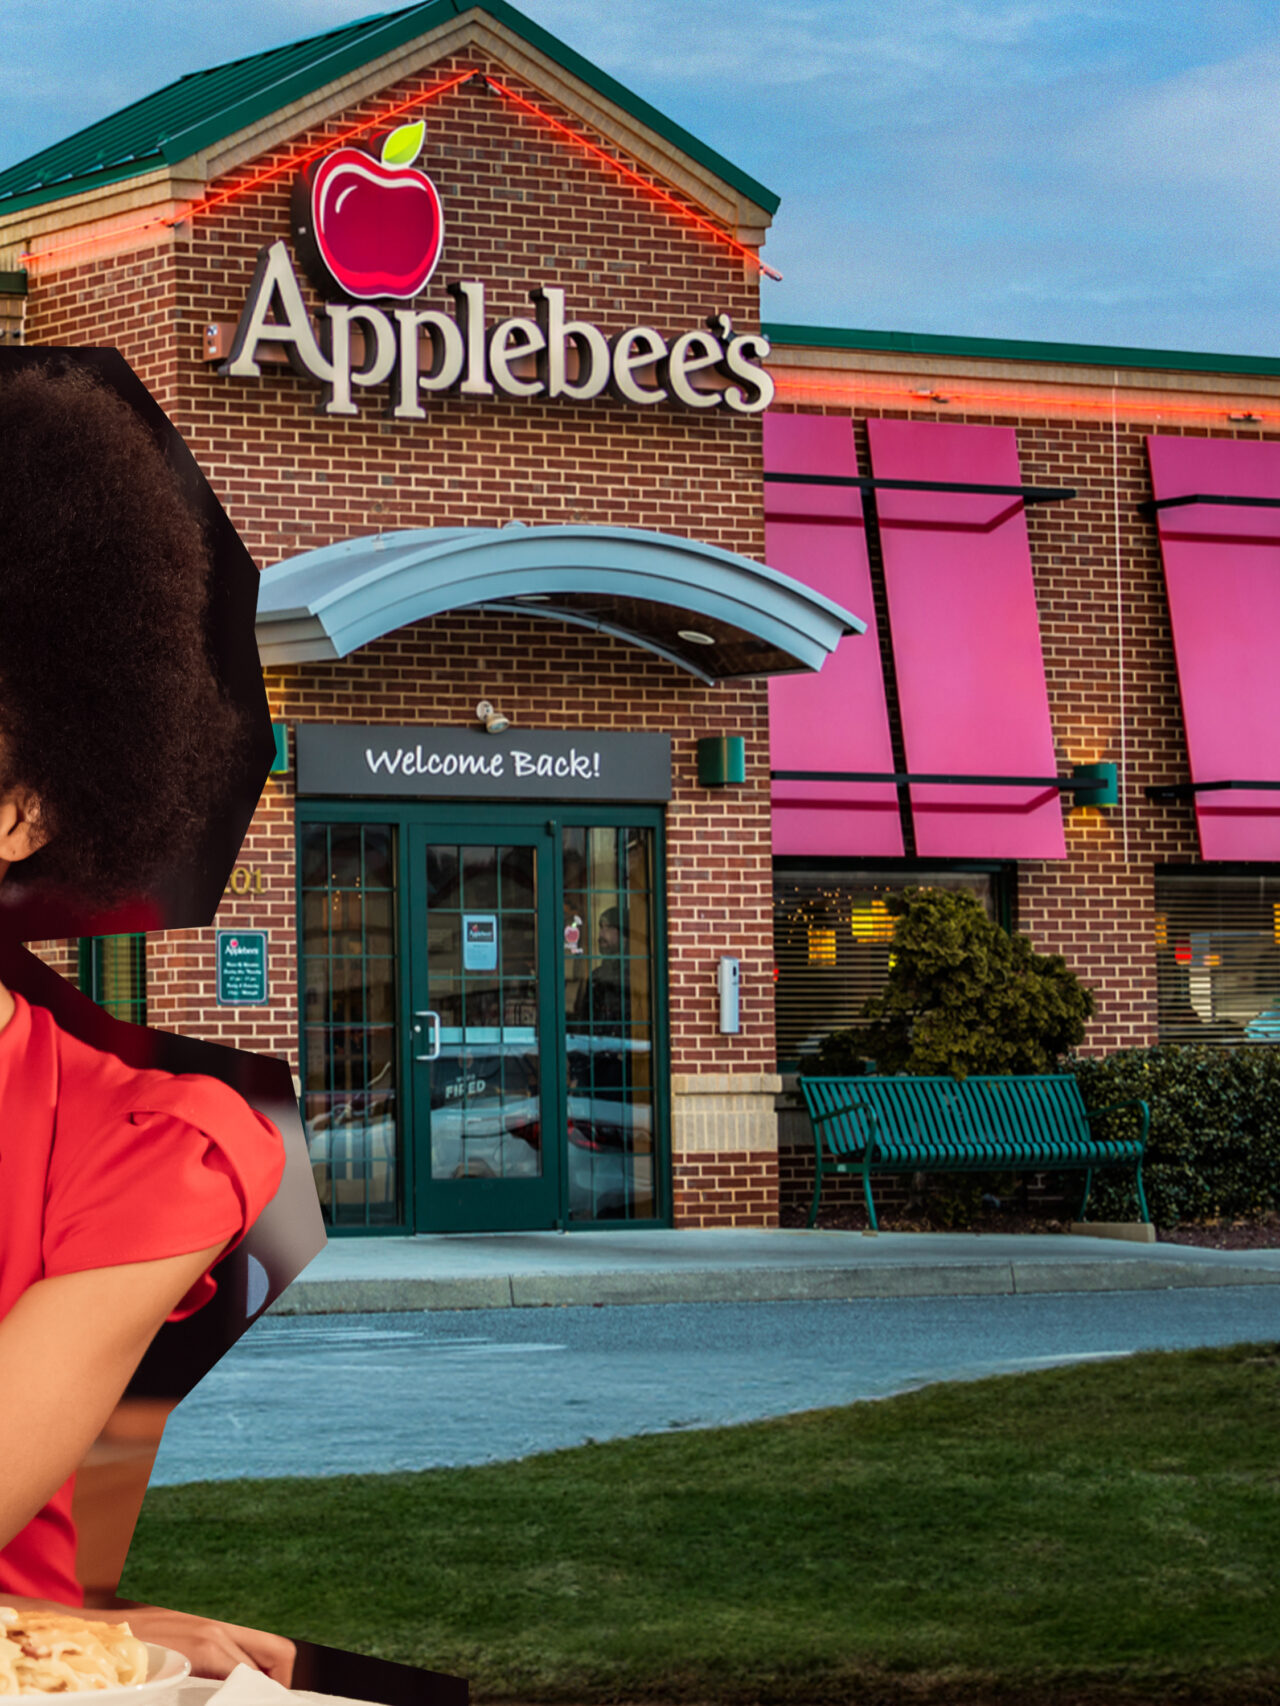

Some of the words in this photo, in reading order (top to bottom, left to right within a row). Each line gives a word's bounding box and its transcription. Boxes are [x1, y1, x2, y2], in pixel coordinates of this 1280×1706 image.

[226, 239, 776, 418] Applebee's
[365, 744, 505, 777] Welcome
[509, 748, 602, 780] Back!
[223, 866, 267, 895] 01
